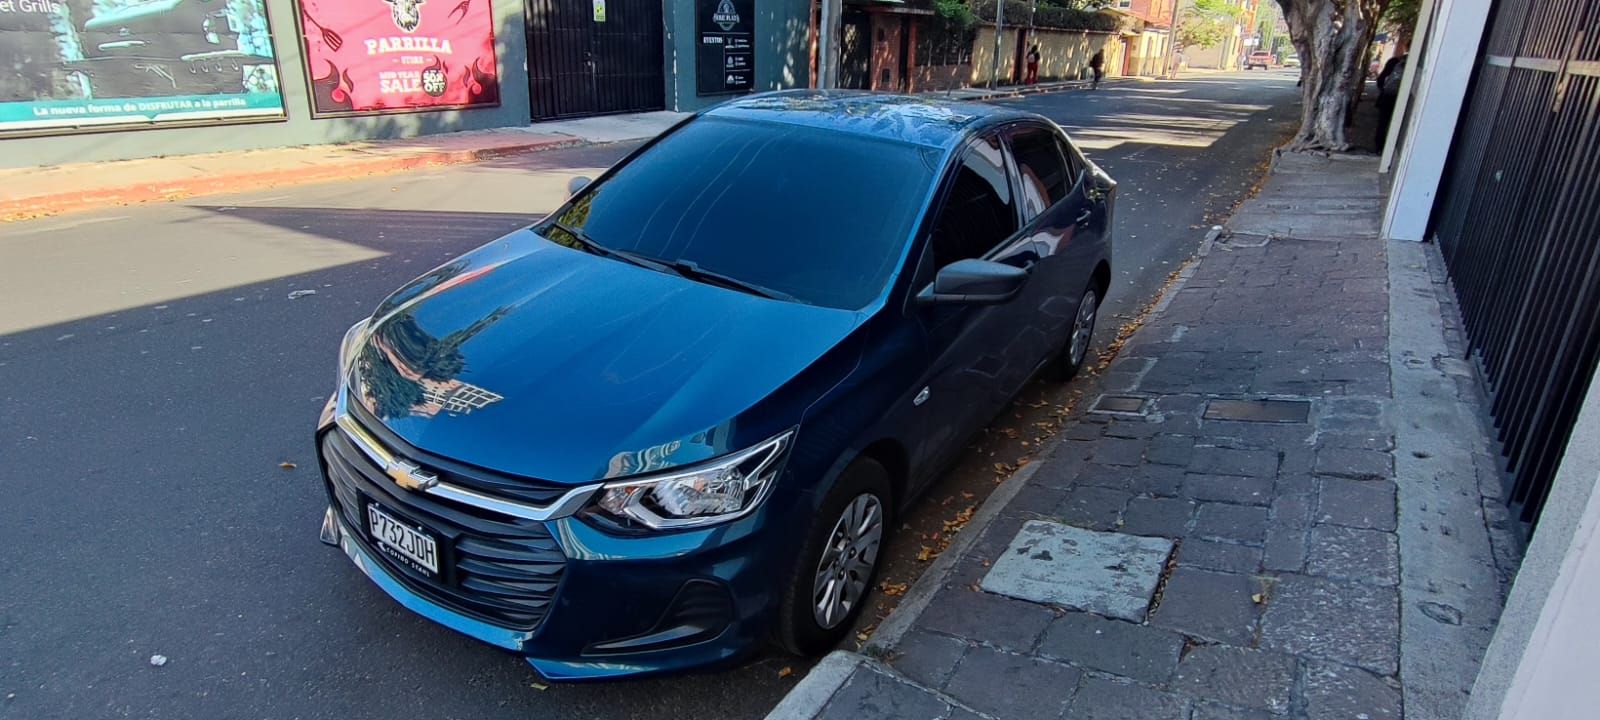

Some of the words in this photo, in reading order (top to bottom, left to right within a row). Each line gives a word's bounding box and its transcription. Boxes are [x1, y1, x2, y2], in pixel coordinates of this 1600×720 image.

[20, 0, 61, 13] Grills
[364, 36, 453, 55] PARRILLA
[380, 80, 423, 93] SALE
[424, 83, 445, 93] OFF
[33, 107, 49, 116] La
[50, 106, 86, 115] nueva
[87, 104, 122, 113] forma
[123, 103, 137, 112] de
[138, 101, 193, 111] DISFRUTAR
[202, 99, 212, 108] la
[213, 98, 246, 108] parrilla
[370, 508, 435, 567] P732JDH
